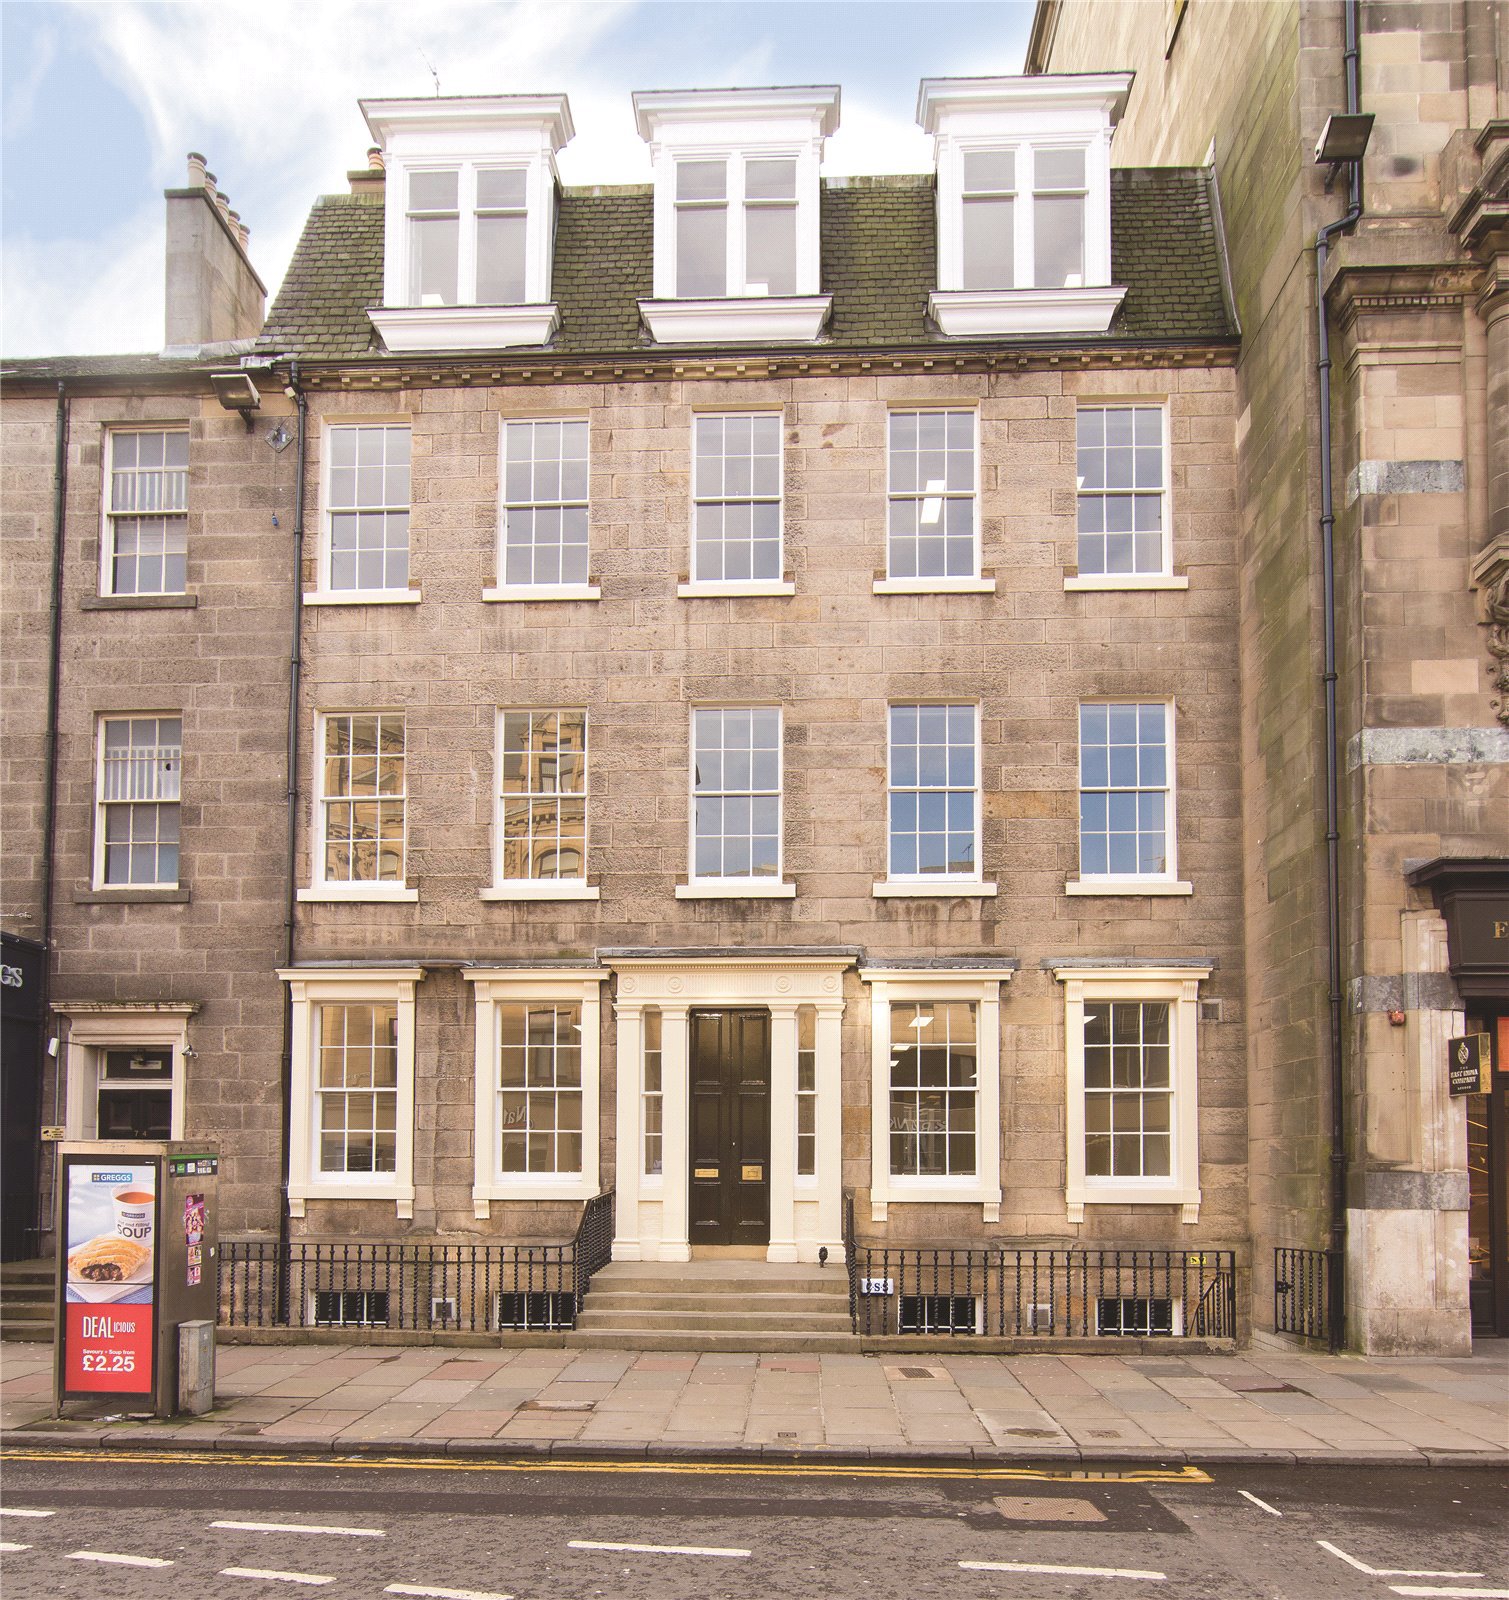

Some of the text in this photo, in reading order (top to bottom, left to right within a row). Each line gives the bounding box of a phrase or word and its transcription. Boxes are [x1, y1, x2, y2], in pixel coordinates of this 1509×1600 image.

[100, 1174, 131, 1182] GREGGS
[117, 1223, 152, 1239] SOUP
[82, 1354, 135, 1372] £2.25
